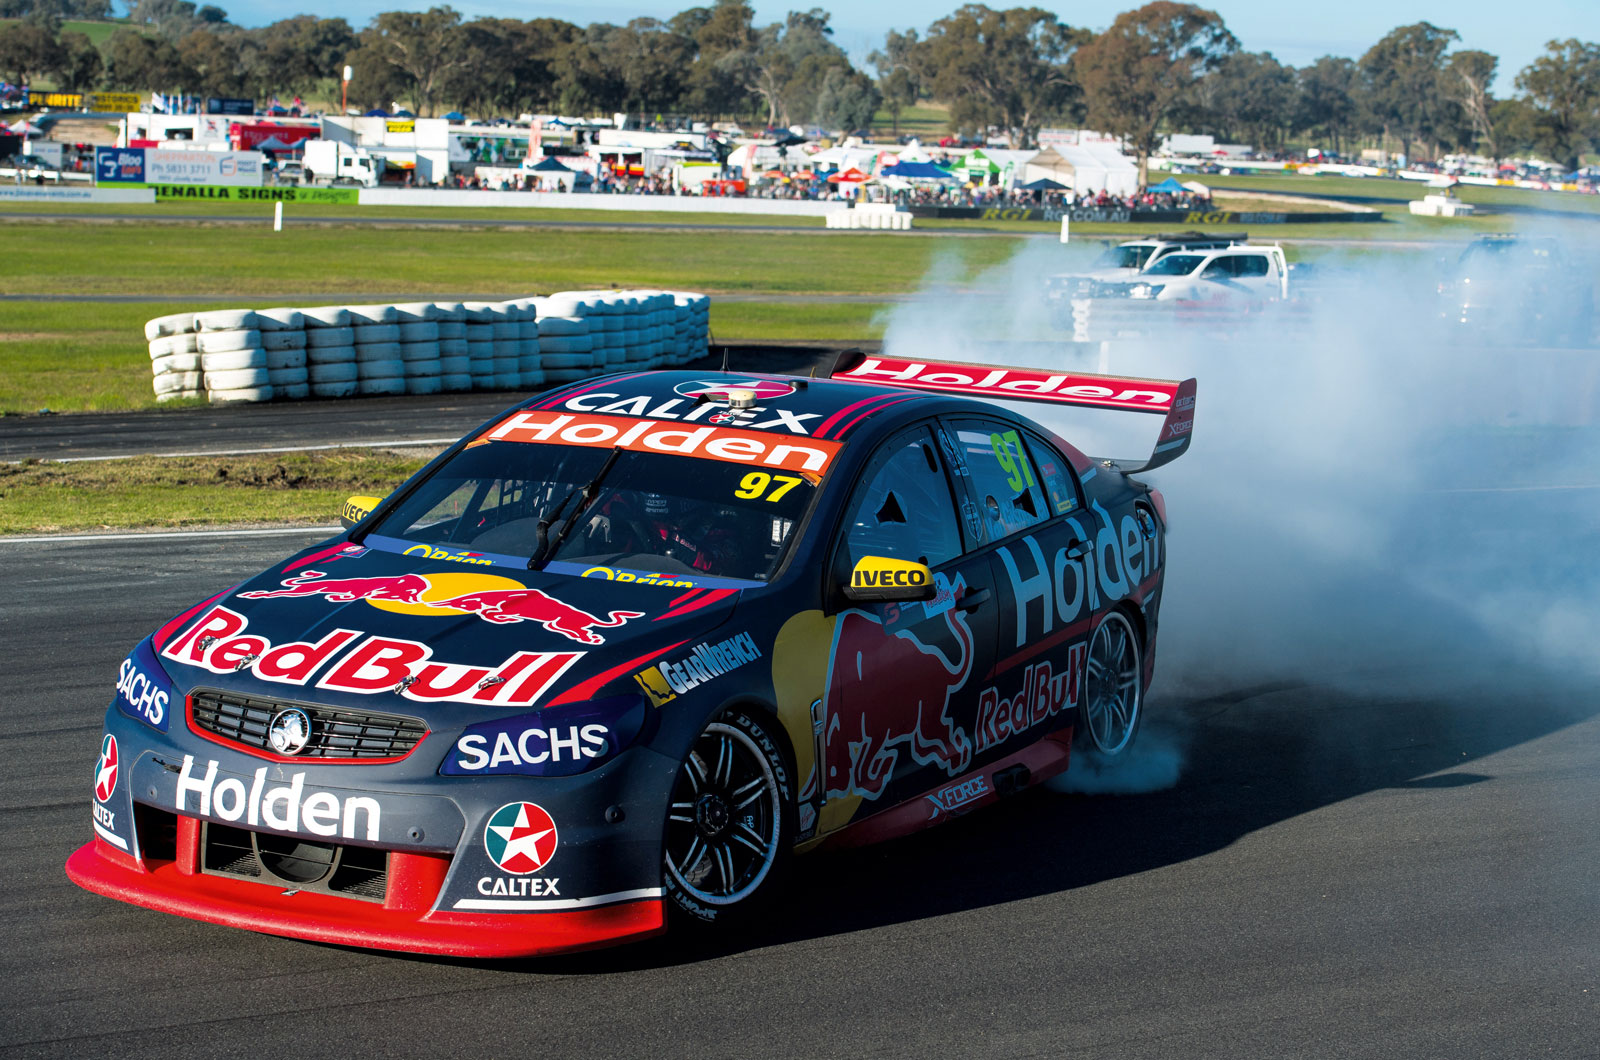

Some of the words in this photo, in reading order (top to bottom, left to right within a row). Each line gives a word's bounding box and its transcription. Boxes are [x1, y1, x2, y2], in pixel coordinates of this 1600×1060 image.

[238, 188, 297, 201] SIGNS
[981, 208, 1033, 221] RGI
[846, 360, 1172, 404] Holden
[565, 393, 823, 434] CALTEX
[488, 413, 829, 471] Holden
[990, 430, 1034, 492] 97
[735, 472, 803, 503] 97
[855, 569, 925, 587] IVECO
[995, 498, 1159, 648] Holden
[116, 657, 170, 725] SACHS
[457, 724, 609, 771] SACHS
[175, 754, 382, 842] Holden
[478, 877, 560, 897] CALTEX
